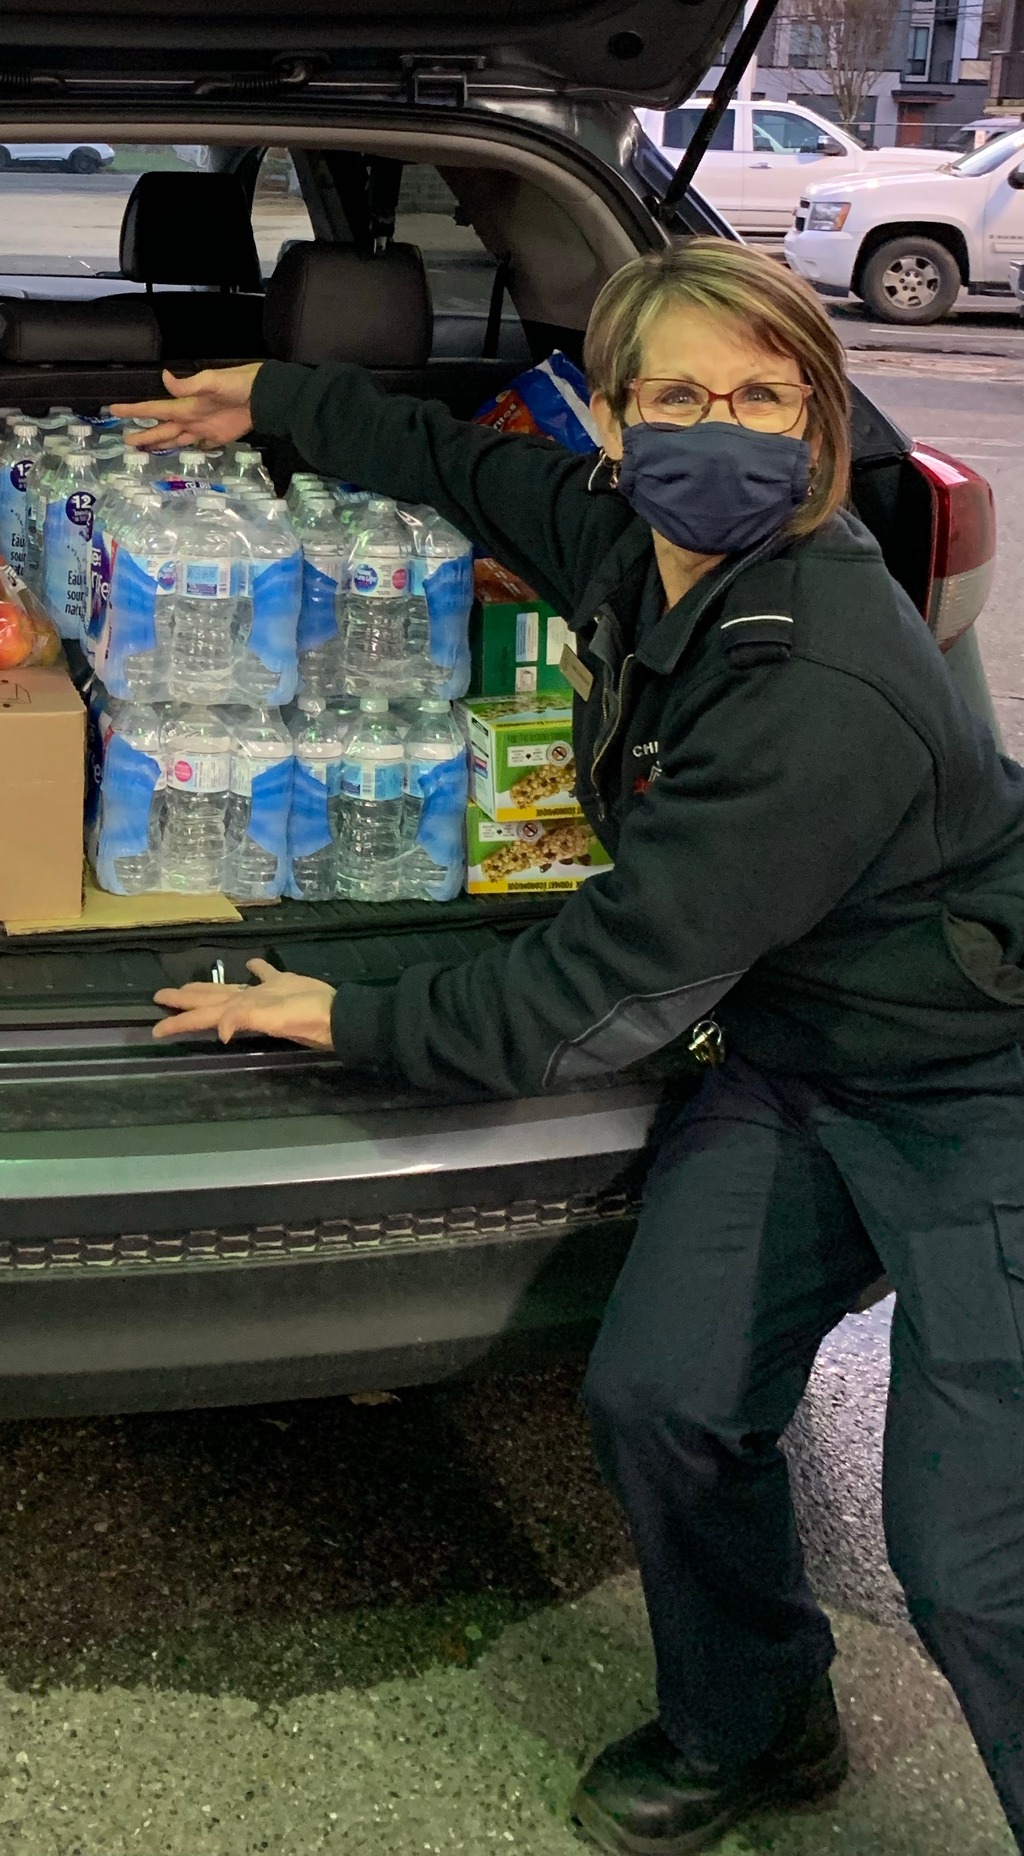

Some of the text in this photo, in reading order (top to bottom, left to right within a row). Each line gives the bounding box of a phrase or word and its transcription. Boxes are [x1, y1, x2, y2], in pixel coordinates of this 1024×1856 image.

[72, 494, 92, 509] 12
[67, 570, 82, 585] Eau
[632, 741, 659, 757] CHI
